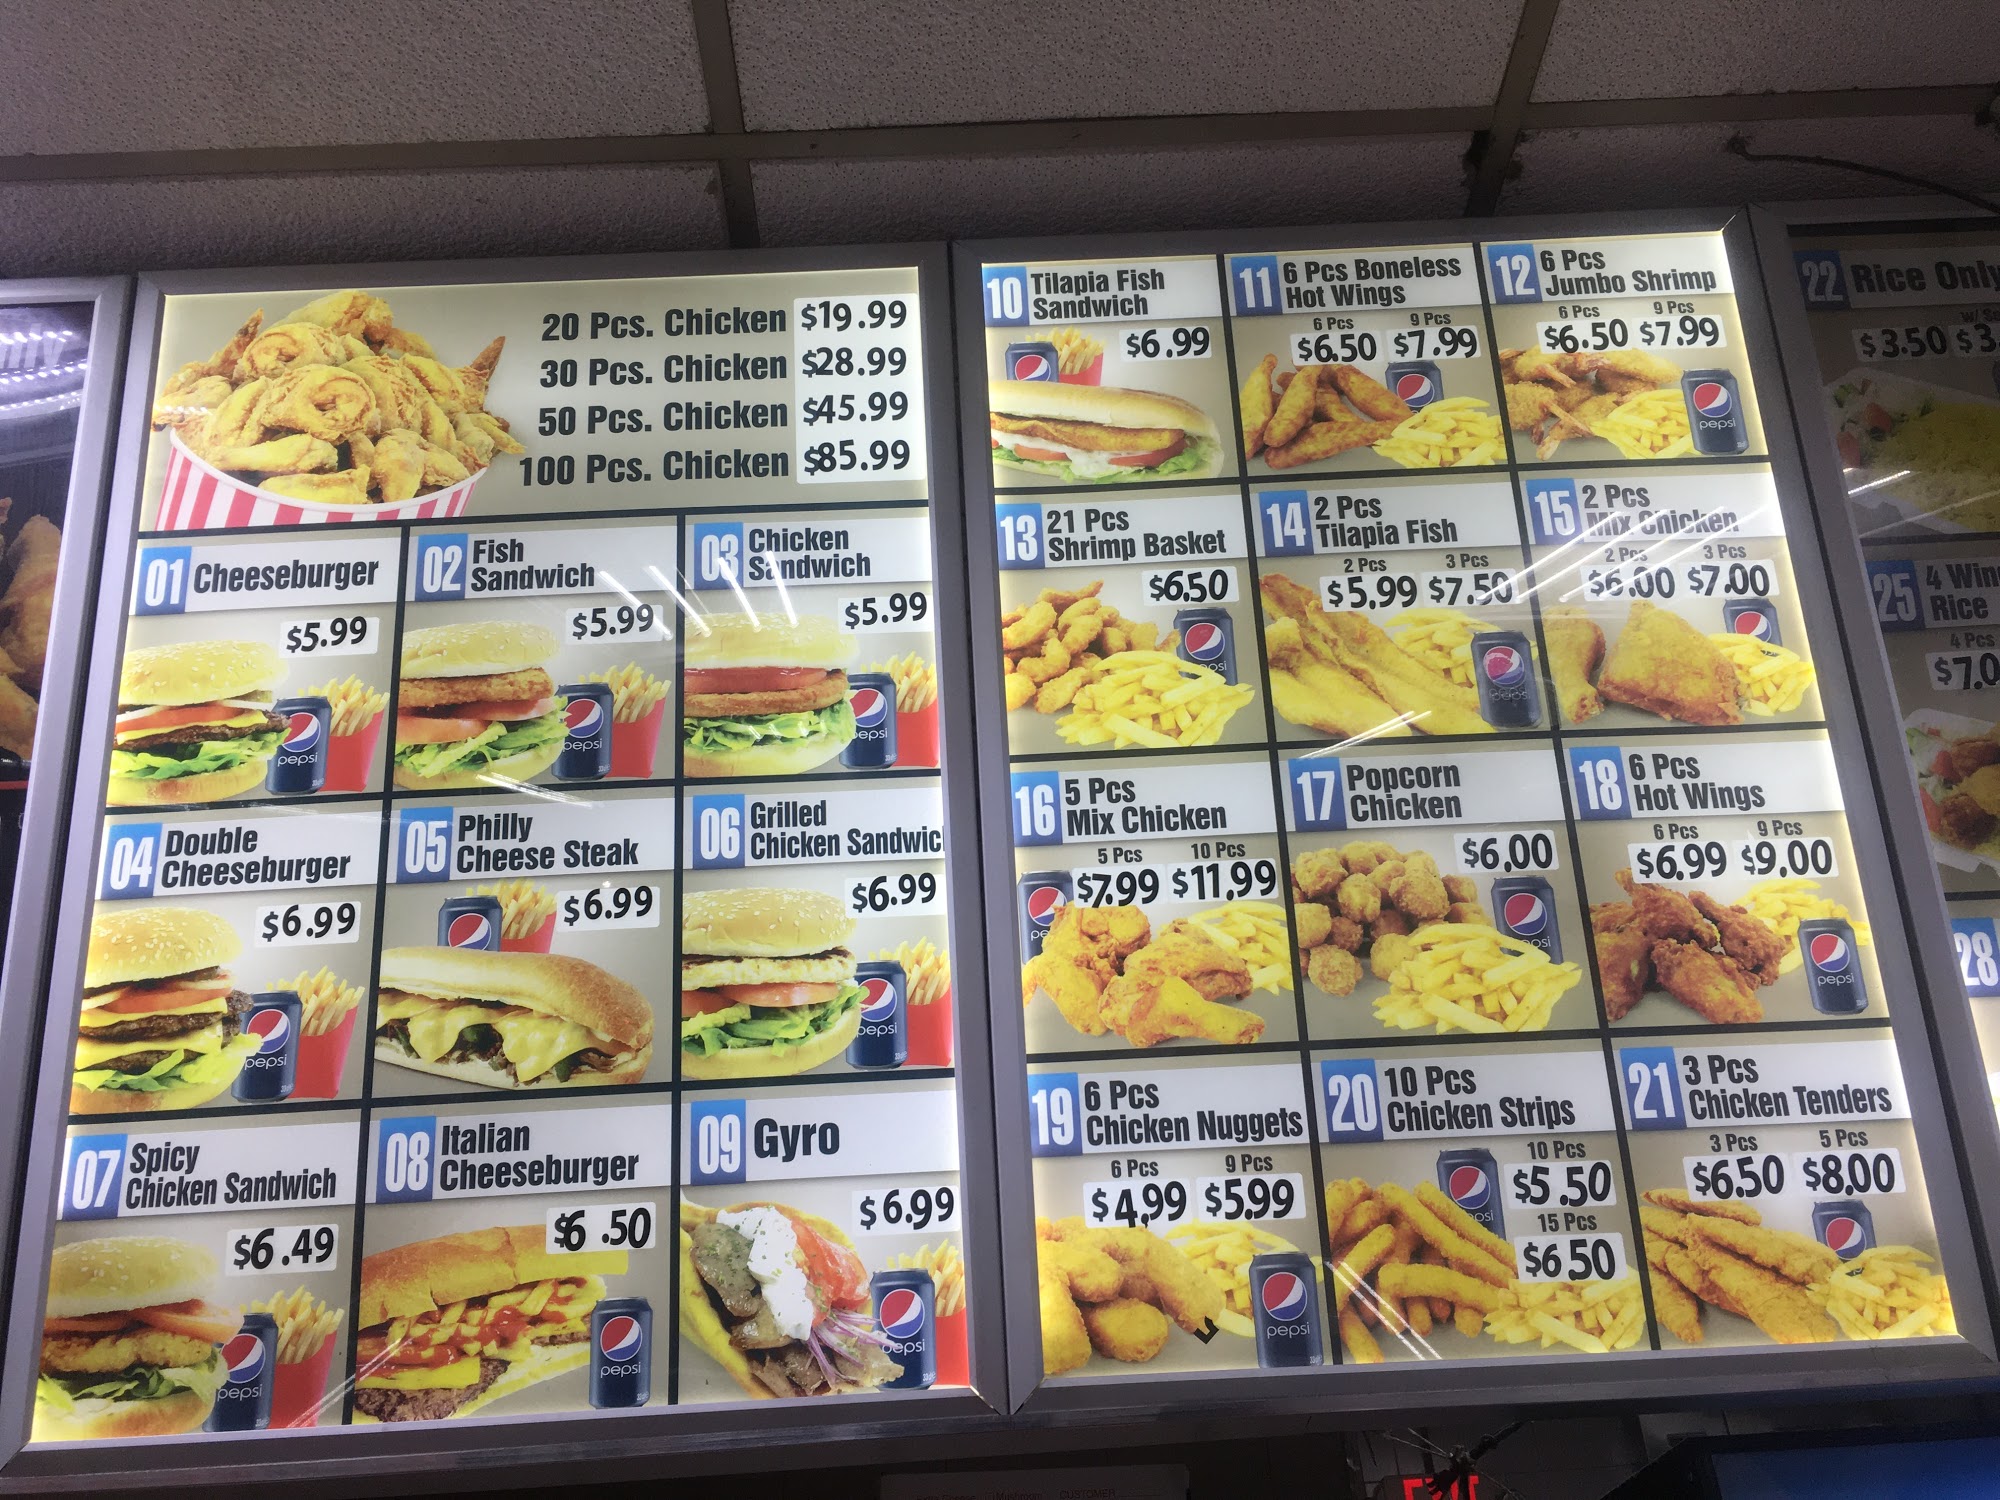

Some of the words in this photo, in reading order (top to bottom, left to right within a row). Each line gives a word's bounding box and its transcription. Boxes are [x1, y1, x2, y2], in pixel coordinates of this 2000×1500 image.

[1283, 262, 1297, 284] 6
[1305, 262, 1348, 282] Pcs
[1355, 257, 1461, 280] Boneless
[1496, 255, 1535, 295] 12
[1540, 251, 1555, 272] 6
[1561, 250, 1605, 270] Pcs
[1031, 271, 1109, 296] Tilapia
[1117, 269, 1164, 291] Fish
[1240, 267, 1272, 308] 11
[1546, 273, 1625, 296] Jumbo
[1632, 269, 1716, 292] Shrimp
[1802, 260, 1843, 302] 22
[1851, 264, 1926, 293] Rice
[987, 278, 1022, 319] 10
[1034, 294, 1148, 320] Sandwich
[1286, 286, 1325, 308] Hot
[1330, 284, 1404, 308] Wings
[542, 313, 579, 341] 20
[591, 312, 653, 339] Pcs.
[665, 307, 786, 336] Chicken
[802, 301, 906, 331] $19.99
[1545, 319, 1628, 353] $6.50
[1640, 316, 1719, 346] $7.99
[1127, 327, 1209, 357] $6.99
[1298, 333, 1376, 362] $6.50
[1394, 327, 1477, 358] $7.99
[1861, 326, 1947, 358] $3.50
[540, 359, 577, 387] 30
[589, 359, 652, 385] Pcs.
[664, 353, 786, 383] Chicken
[802, 347, 906, 378] $28.99
[539, 407, 576, 436] 50
[588, 406, 651, 434] Pcs.
[664, 400, 787, 431] Chicken
[803, 391, 908, 426] $45.99
[520, 456, 574, 486] 100
[587, 455, 651, 483] Pcs.
[664, 449, 788, 480] Chicken
[804, 440, 909, 476] $85.99
[1314, 497, 1330, 520] 2
[1337, 496, 1382, 519] Pcs
[1582, 485, 1598, 508] 2
[1604, 485, 1650, 508] Pcs
[1047, 510, 1074, 534] 21
[1085, 509, 1129, 532] Pcs
[1267, 503, 1306, 547] 14
[1535, 491, 1579, 541] 15
[749, 528, 848, 553] Chicken
[1000, 515, 1037, 560] 13
[1049, 536, 1136, 561] Shrimp
[1144, 530, 1226, 556] Basket
[1316, 521, 1399, 549] Tilapia
[1406, 519, 1457, 543] Fish
[423, 545, 462, 592] 02
[473, 539, 523, 564] Fish
[702, 534, 740, 586] 03
[749, 553, 870, 580] Sandwich
[145, 559, 183, 606] 01
[194, 560, 379, 593] Cheeseburger
[471, 563, 598, 596] Sandwich
[1150, 570, 1228, 602] $6.50
[1328, 576, 1417, 609] $5.99
[1429, 572, 1512, 605] $7.50
[1688, 563, 1769, 596] $7.00
[845, 592, 927, 629] $5.99
[1873, 573, 1916, 621] 25
[1930, 595, 1988, 621] Rice
[287, 616, 367, 653] $5.99
[573, 604, 653, 640] $5.99
[277, 752, 318, 767] pepsi
[1629, 754, 1645, 780] 6
[1652, 754, 1700, 779] Pcs
[1065, 779, 1080, 805] 5
[1089, 778, 1135, 804] Pcs
[1297, 771, 1335, 821] 17
[1347, 765, 1460, 793] Popcorn
[1579, 760, 1622, 810] 18
[1015, 785, 1055, 836] 16
[1351, 793, 1462, 822] Chicken
[1634, 785, 1679, 810] Hot
[1682, 782, 1765, 811] Wings
[459, 813, 533, 842] Philly
[751, 800, 826, 829] Grilled
[1067, 809, 1115, 836] Mix
[1122, 804, 1227, 833] Chicken
[1654, 824, 1664, 840] 6
[1668, 823, 1698, 839] Pcs
[1757, 821, 1768, 836] 9
[1772, 820, 1803, 836] Pcs
[165, 827, 257, 856] Double
[405, 821, 447, 873] 05
[701, 808, 739, 859] 06
[751, 831, 840, 859] Chicken
[1191, 843, 1210, 859] 10
[1216, 842, 1245, 858] Pcs
[110, 837, 153, 889] 04
[457, 839, 554, 873] Cheese
[564, 839, 638, 868] Steak
[1098, 848, 1107, 864] 5
[1113, 847, 1142, 863] Pcs
[1463, 834, 1552, 872] $6.00
[1637, 842, 1726, 880] $6.99
[1742, 840, 1832, 877] $9.00
[162, 856, 354, 887] Cheeseburger
[1078, 869, 1159, 908] $7.99
[1173, 860, 1276, 901] $11.99
[564, 886, 652, 926] $6.99
[853, 873, 936, 913] $6.99
[262, 903, 355, 942] $6.99
[1818, 973, 1854, 987] pepsi
[1385, 1067, 1417, 1097] 10
[1425, 1066, 1476, 1095] Pcs
[1683, 1056, 1701, 1085] 3
[1707, 1055, 1758, 1084] Pcs
[1085, 1081, 1100, 1111] 6
[1110, 1081, 1159, 1110] Pcs
[1329, 1074, 1377, 1131] 20
[1629, 1063, 1675, 1118] 21
[1689, 1088, 1789, 1120] Chicken
[1793, 1084, 1892, 1115] Tenders
[1032, 1088, 1073, 1145] 19
[1087, 1114, 1190, 1146] Chicken
[1197, 1108, 1303, 1142] Nuggets
[1388, 1100, 1493, 1132] Chicken
[1499, 1096, 1575, 1129] Strips
[442, 1123, 529, 1155] Italian
[699, 1115, 740, 1174] 09
[754, 1118, 839, 1162] Gyro
[1527, 1141, 1548, 1159] 10
[1553, 1141, 1586, 1158] Pcs
[130, 1142, 200, 1176] Spicy
[386, 1132, 429, 1192] 08
[440, 1155, 638, 1191] Cheeseburger
[1803, 1153, 1894, 1196] $8.00
[72, 1150, 120, 1209] 07
[126, 1176, 217, 1209] Chicken
[224, 1168, 336, 1204] Sandwich
[1514, 1162, 1611, 1207] $5.50
[1693, 1155, 1784, 1199] $6.50
[860, 1187, 954, 1230] $6.99
[1092, 1181, 1186, 1228] $4.99
[1205, 1178, 1294, 1220] $5.99
[1538, 1214, 1559, 1232] 15
[1564, 1213, 1597, 1231] Pcs
[234, 1227, 334, 1269] $6.49
[1267, 1324, 1311, 1339] pepsi
[600, 1361, 641, 1378] pepsi
[217, 1383, 262, 1401] pepsi
